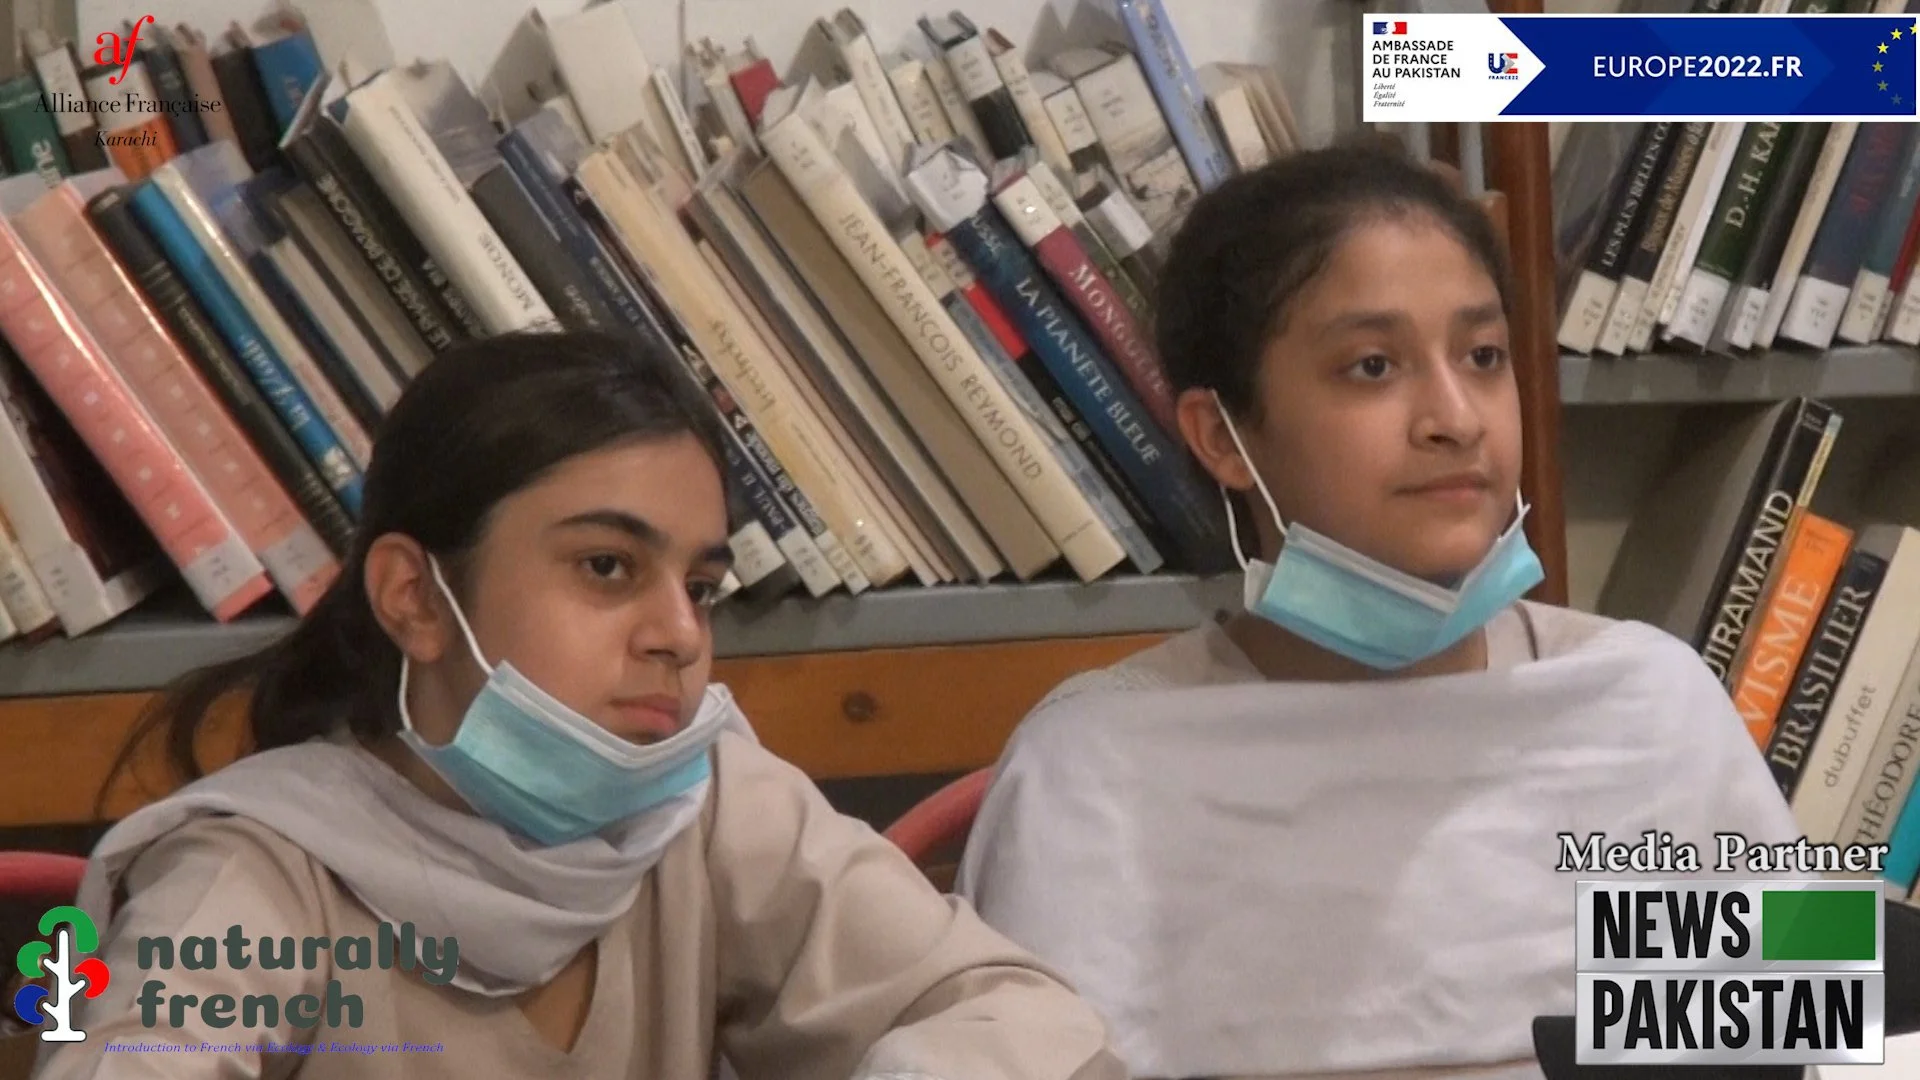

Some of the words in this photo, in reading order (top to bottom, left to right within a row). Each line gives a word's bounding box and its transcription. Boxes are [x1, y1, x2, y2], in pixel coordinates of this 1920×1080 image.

[840, 214, 963, 372] JEAN-FRANÇOIS
[960, 373, 1042, 481] REYMOND
[1016, 277, 1040, 307] LA
[1106, 401, 1161, 466] BLEUE
[1771, 586, 1872, 770] BRASILIER
[1823, 684, 1877, 788] dubuffet
[1856, 703, 1920, 842] HÉODORE
